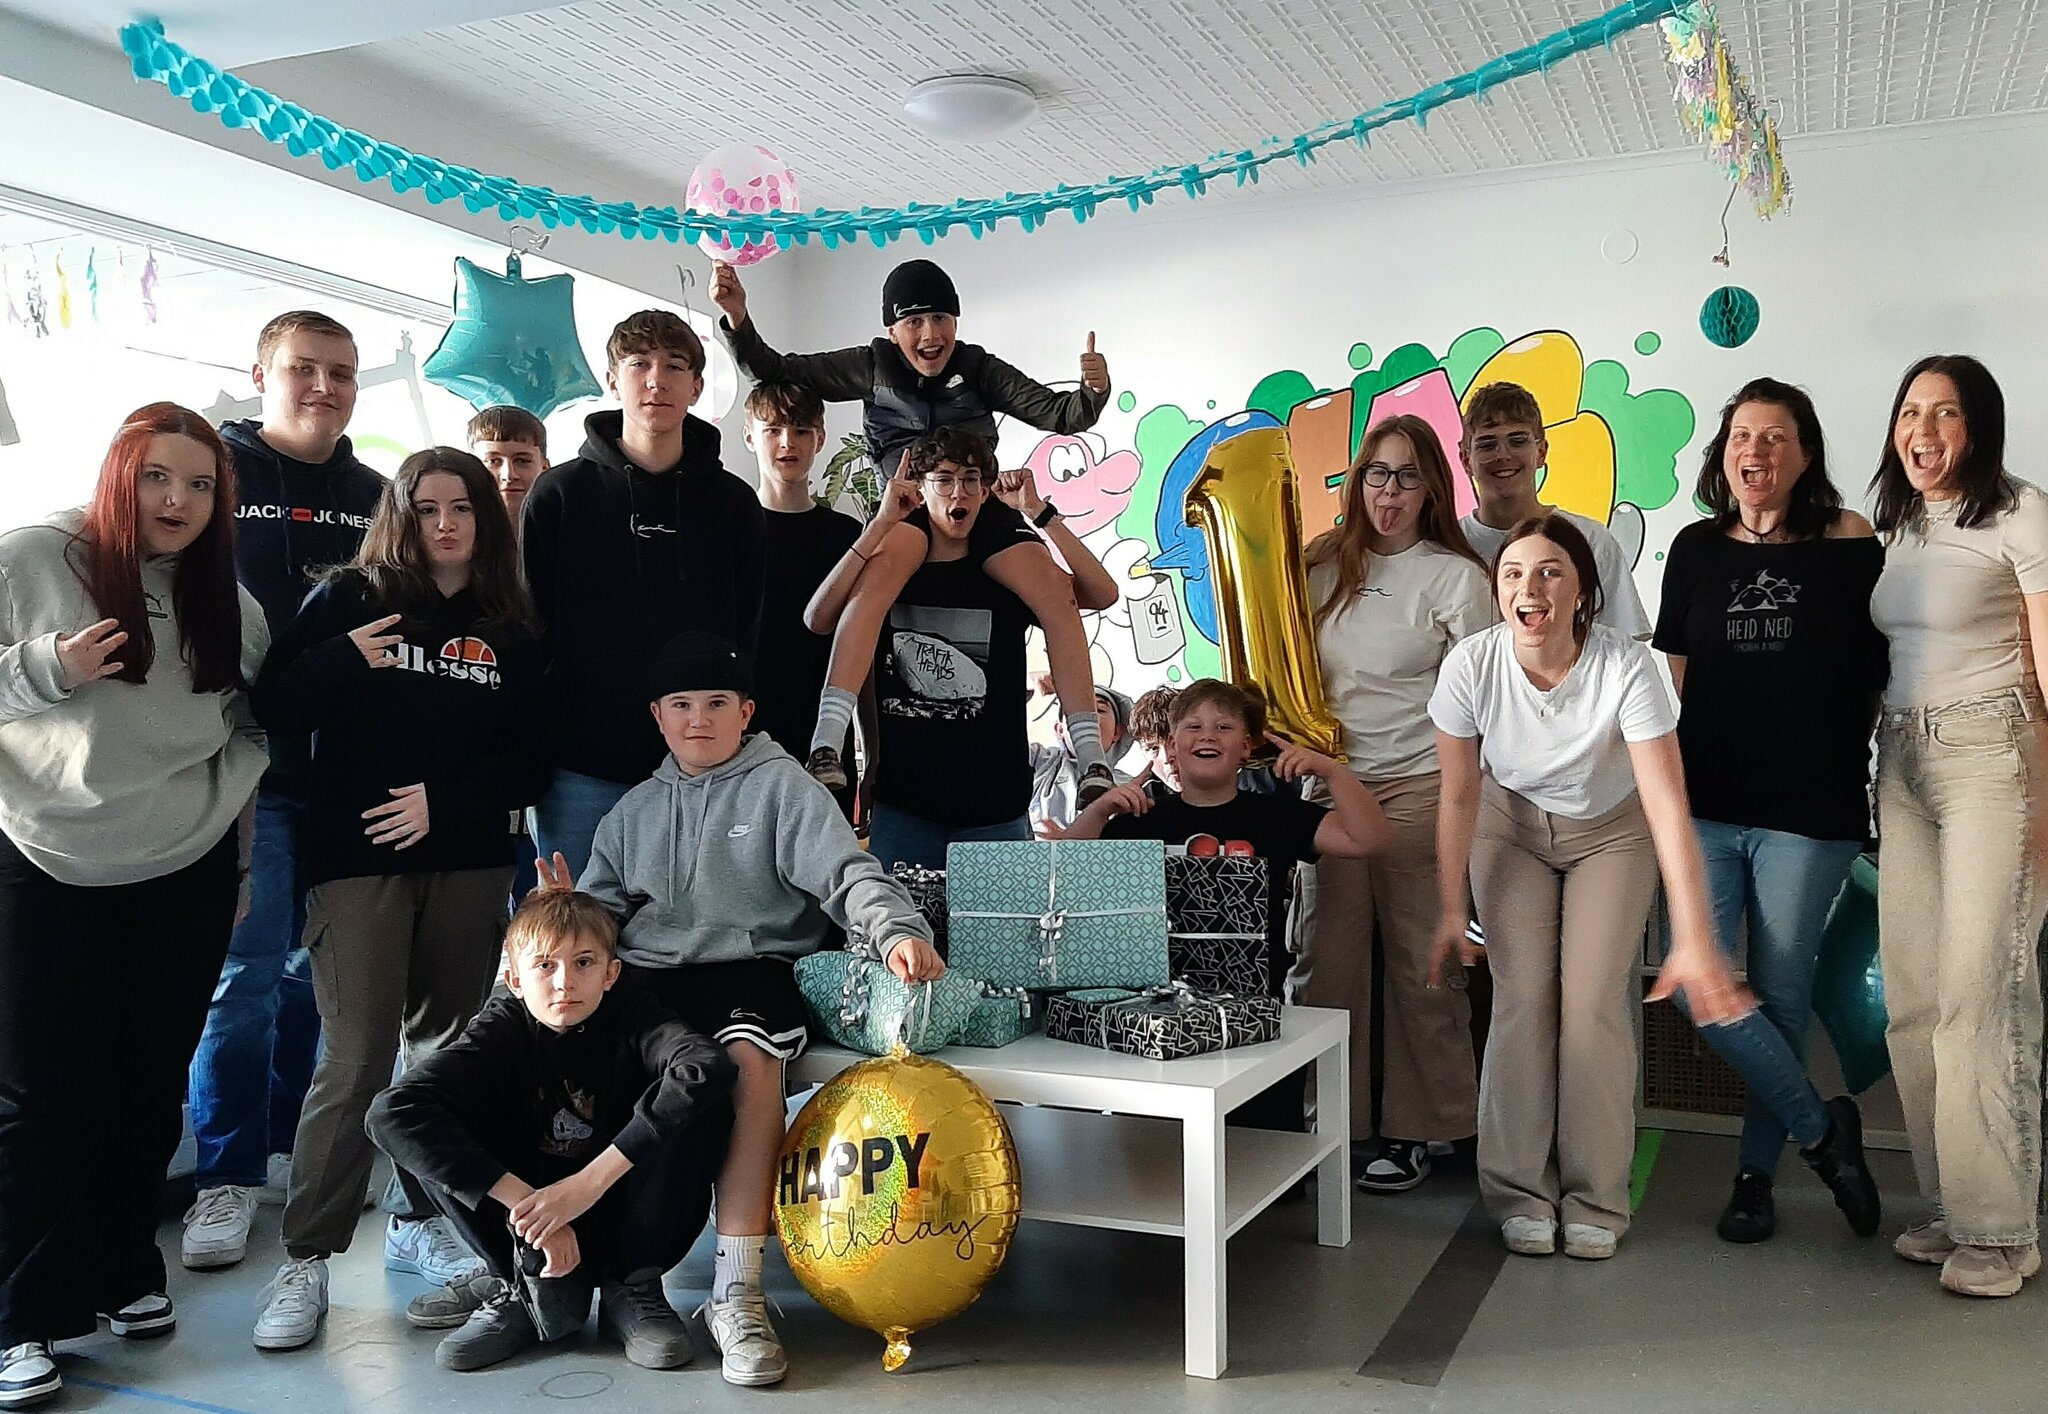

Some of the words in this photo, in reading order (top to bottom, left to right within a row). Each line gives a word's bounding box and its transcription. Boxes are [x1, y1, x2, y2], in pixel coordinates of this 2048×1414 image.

[1727, 618, 1757, 640] HEID
[1764, 616, 1792, 639] NED
[779, 1132, 931, 1206] HAPPY
